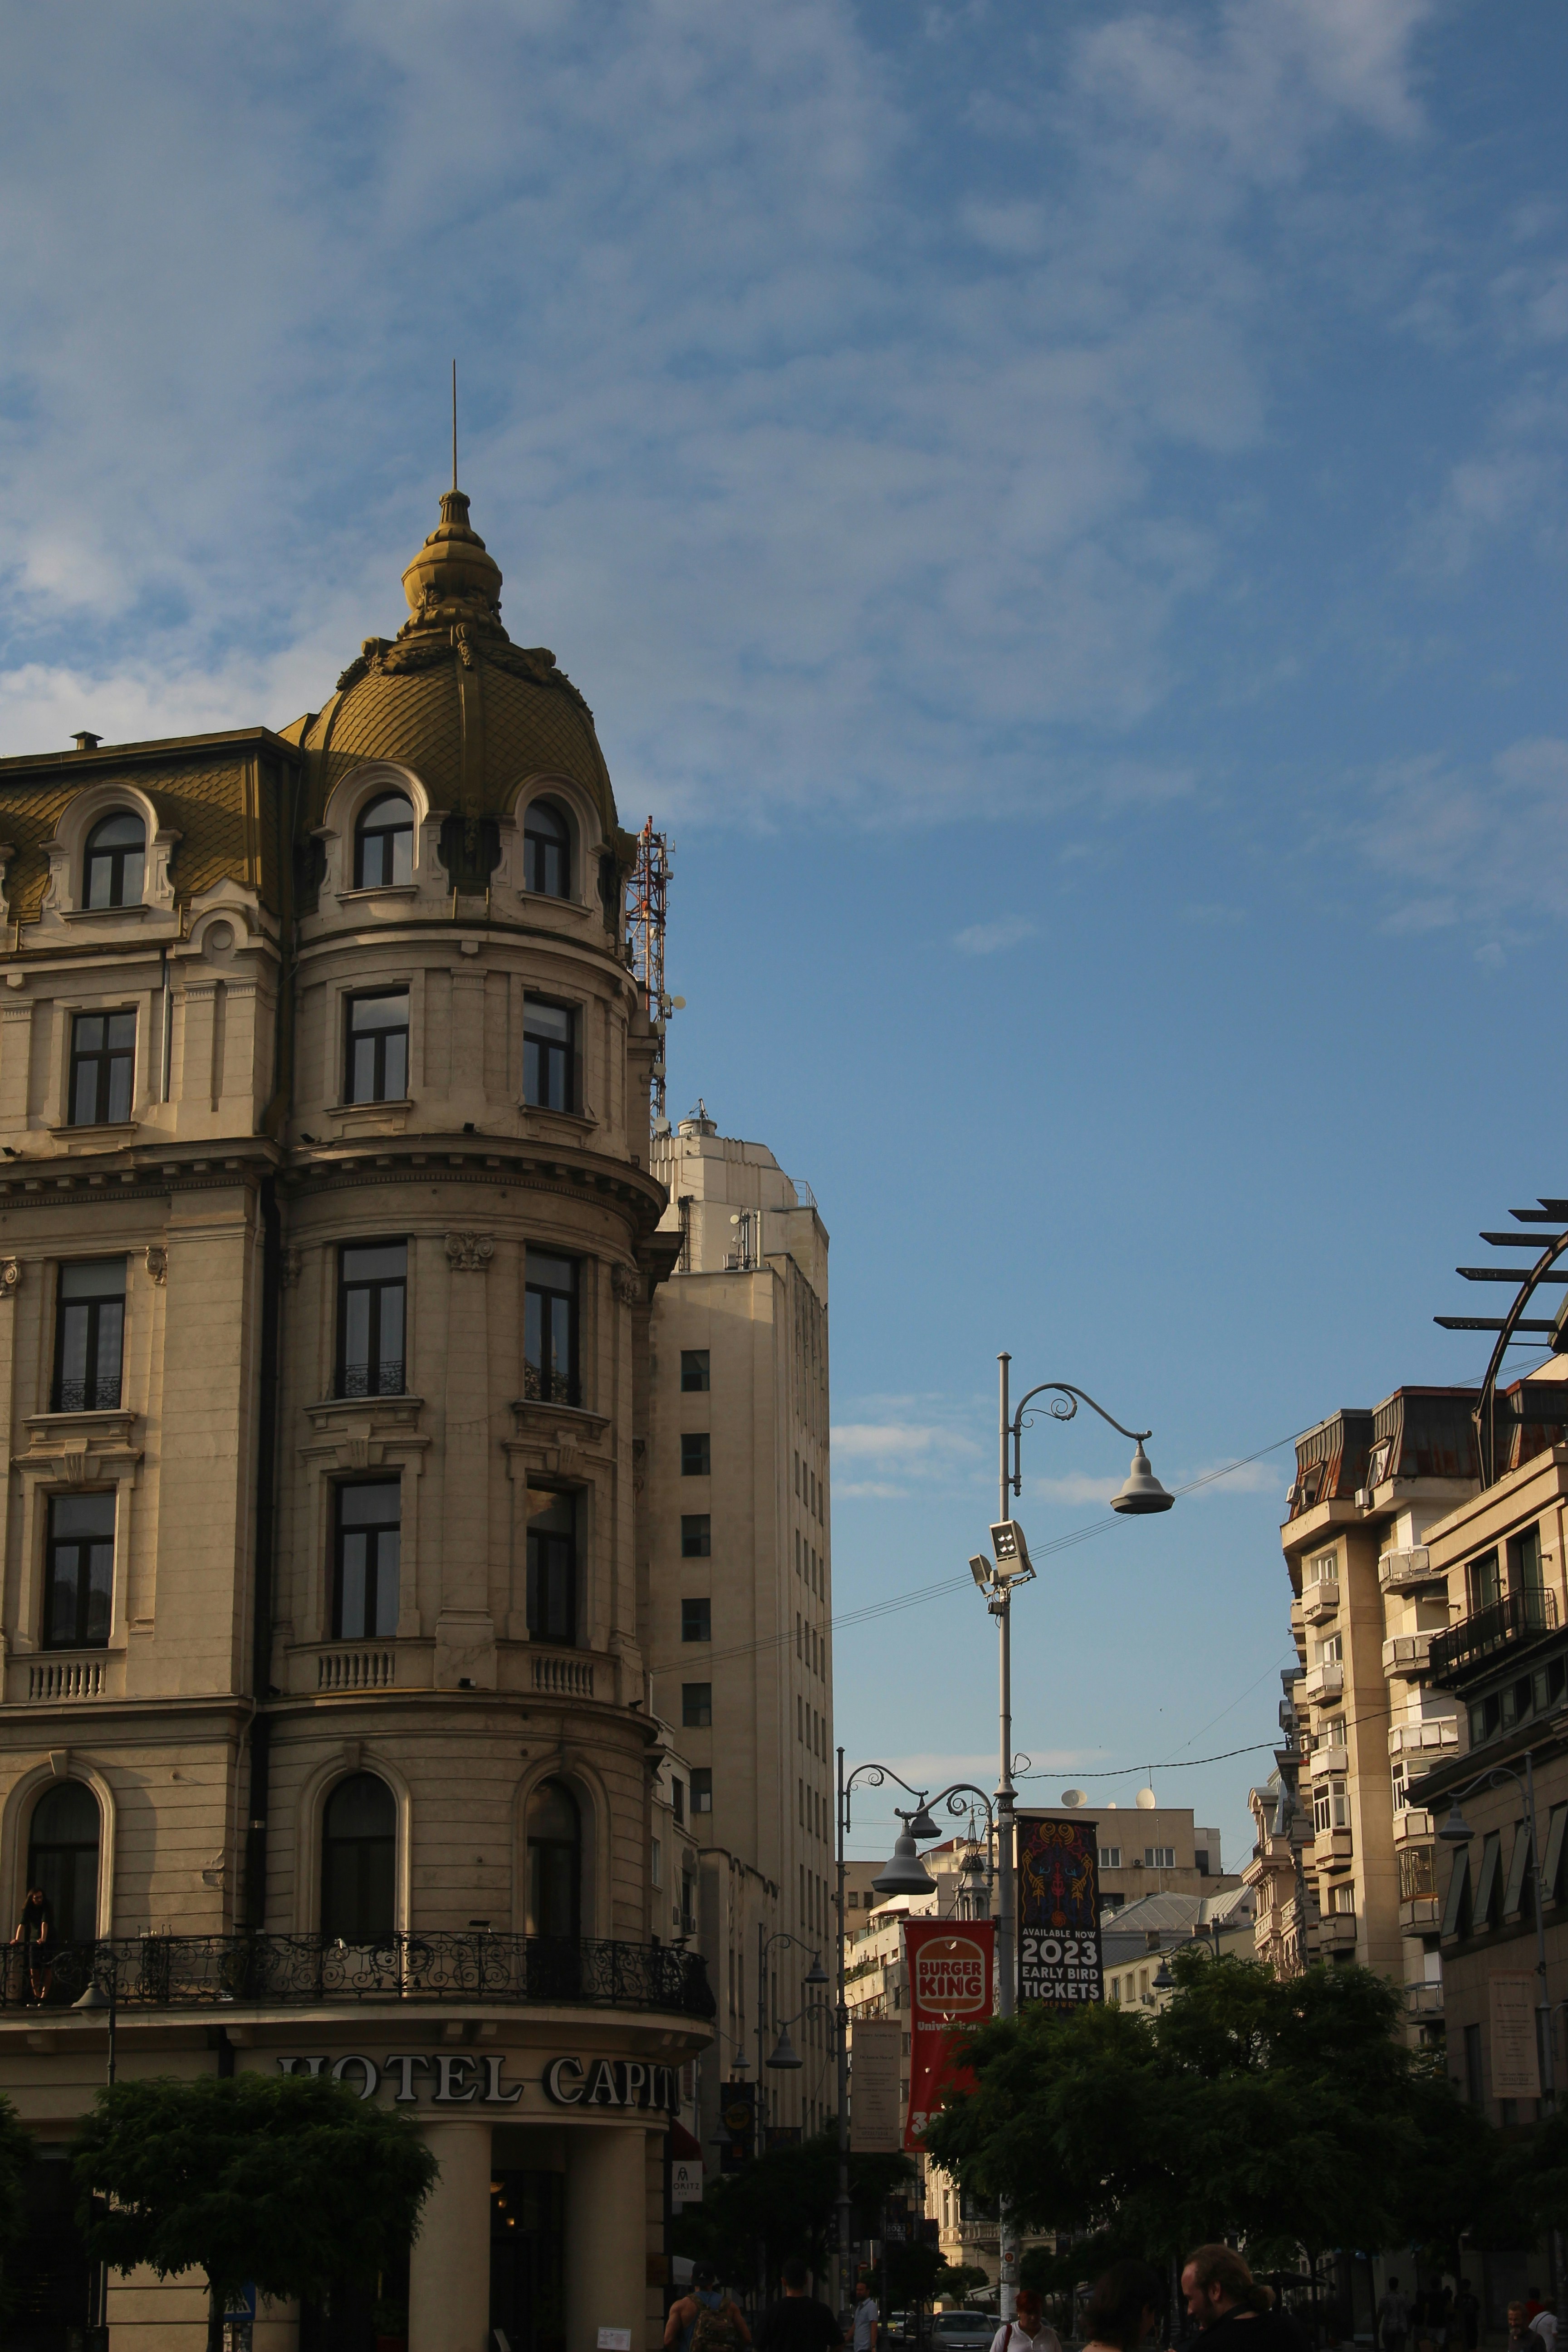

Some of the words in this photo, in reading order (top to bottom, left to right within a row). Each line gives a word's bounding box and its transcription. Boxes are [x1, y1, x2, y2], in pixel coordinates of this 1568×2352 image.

[1023, 1928, 1070, 1937] AVAILABLE
[1075, 1931, 1096, 1939] NOW
[1022, 1938, 1098, 1965] 2023
[919, 1962, 981, 1975] BURGER
[1022, 1966, 1063, 1979] EARLY
[1068, 1968, 1098, 1980] BIRD
[919, 1977, 982, 1996] KING
[1022, 1981, 1099, 1999] TICKETS
